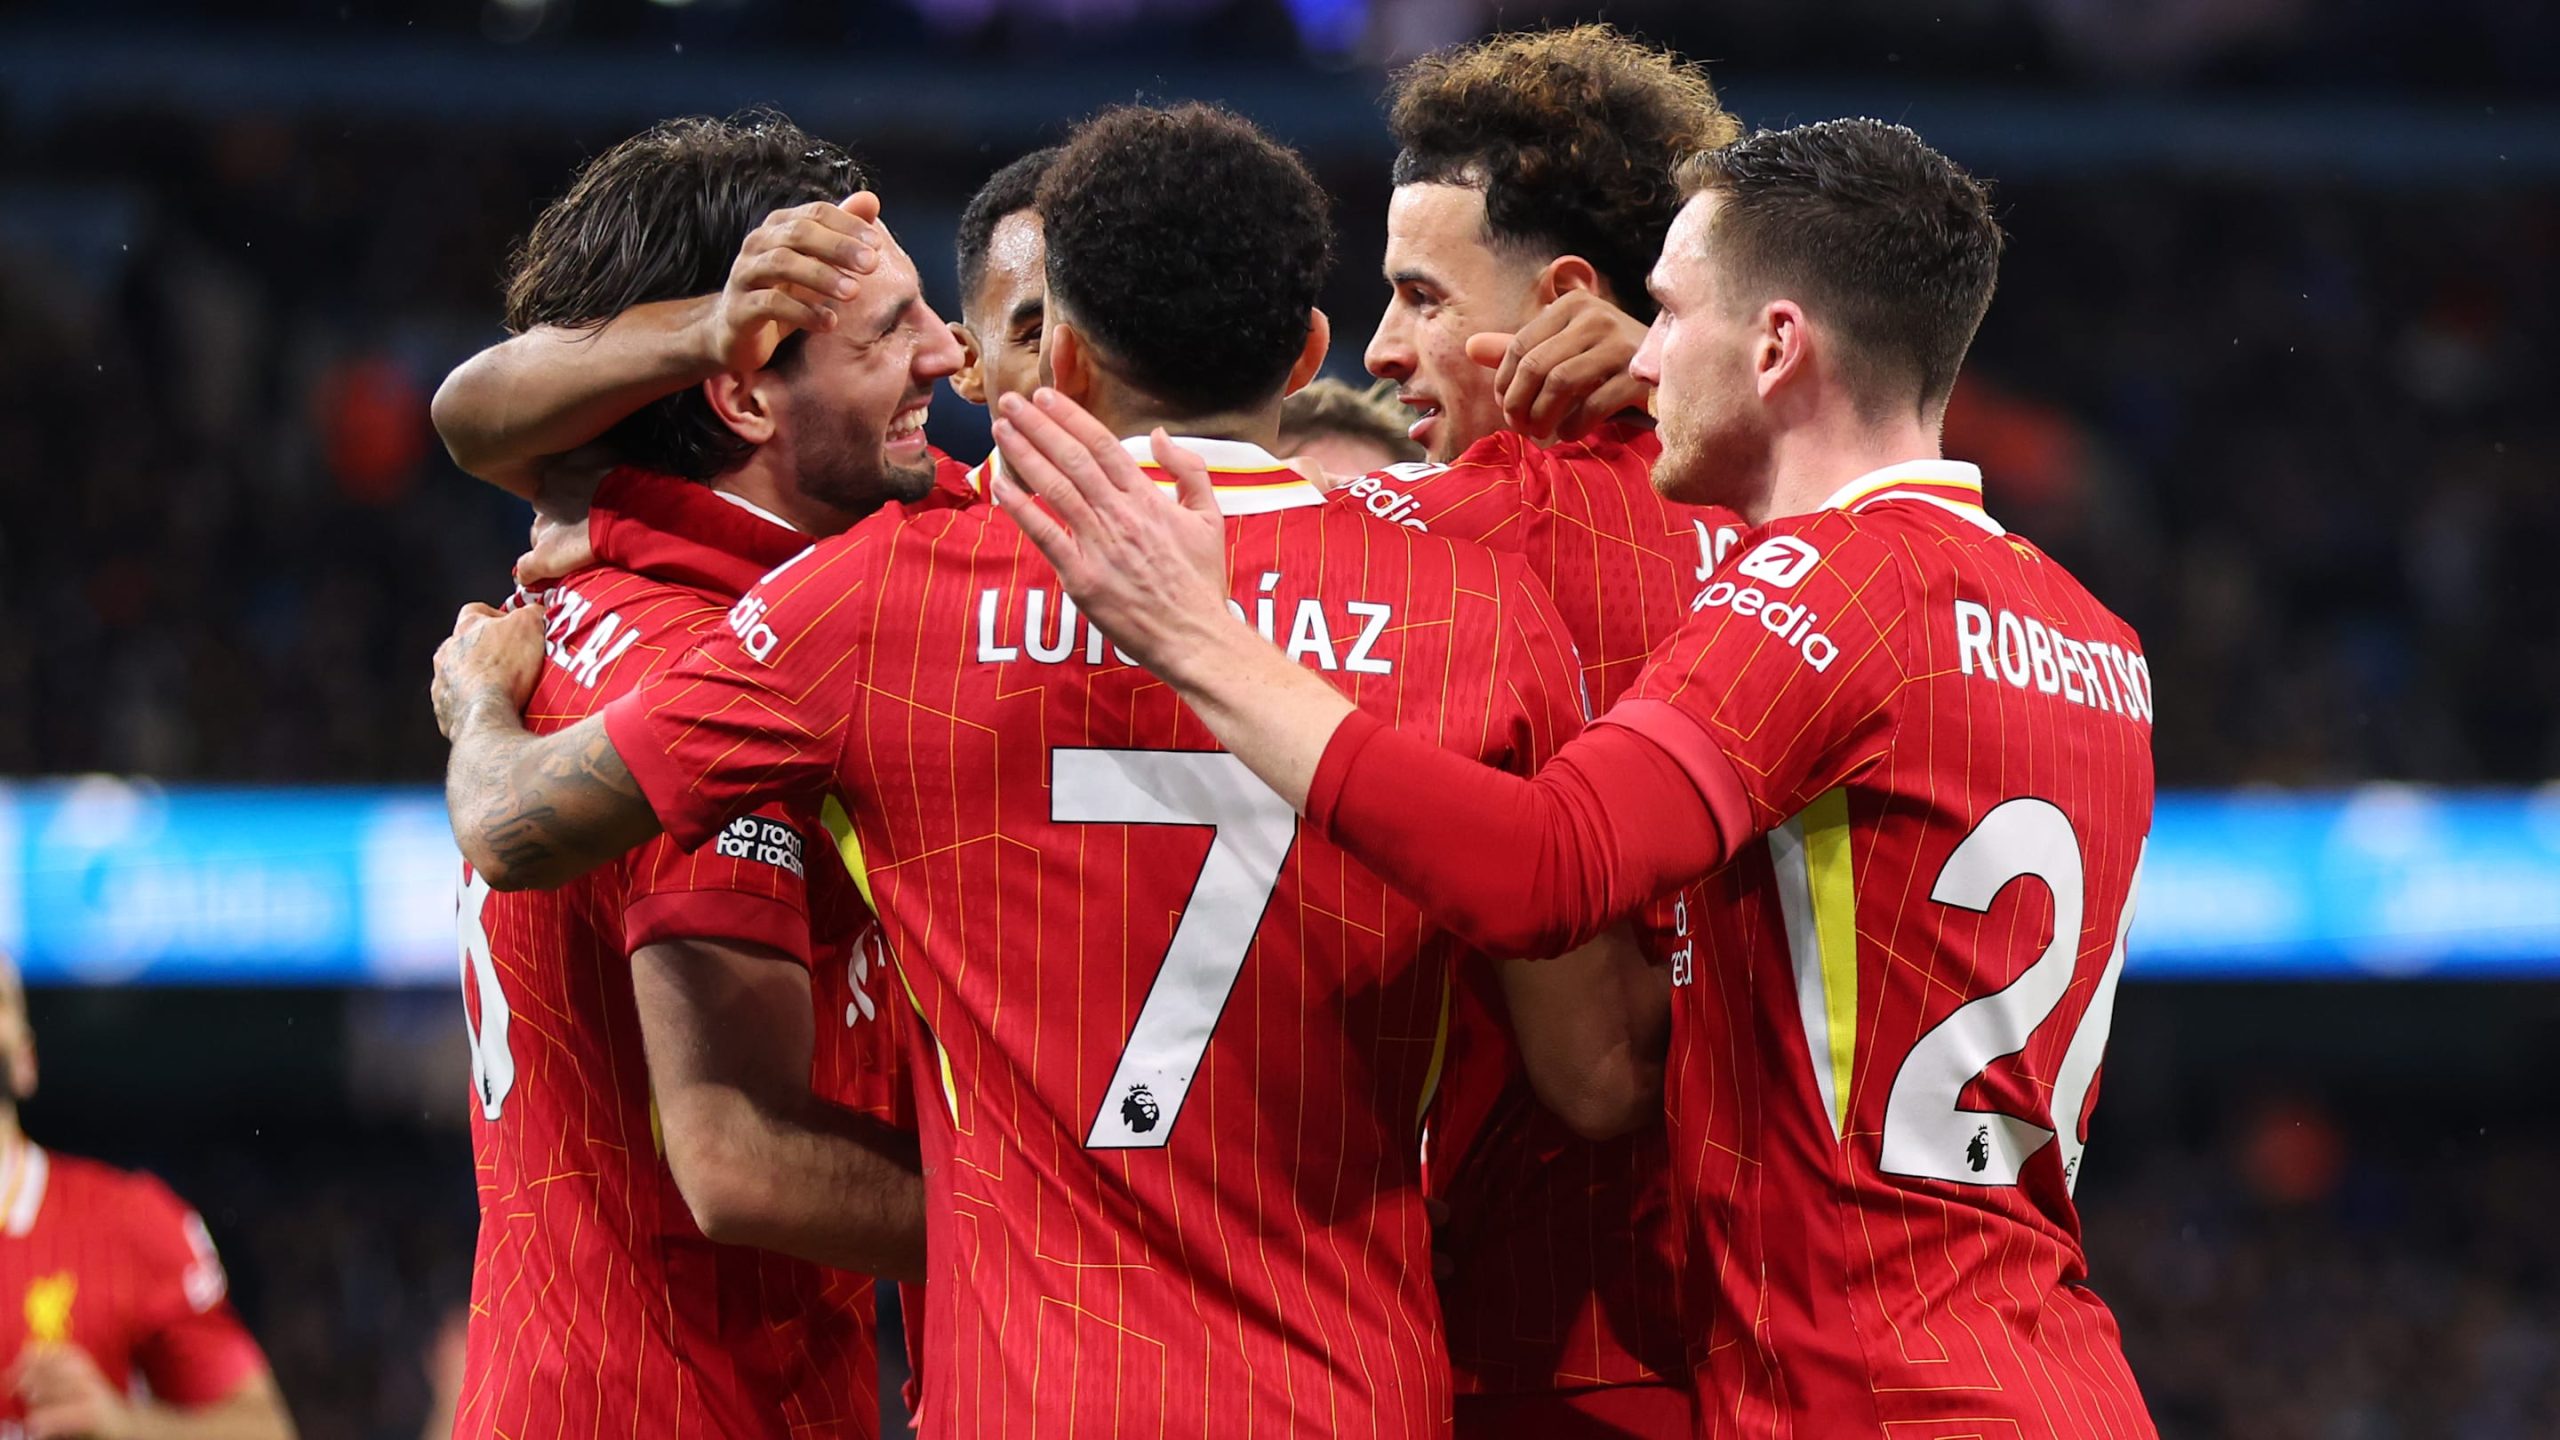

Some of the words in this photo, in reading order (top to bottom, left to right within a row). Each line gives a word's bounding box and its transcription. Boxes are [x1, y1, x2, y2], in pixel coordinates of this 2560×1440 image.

[729, 592, 779, 663] dia
[977, 588, 1139, 665] LUI
[1227, 571, 1393, 674] ÍAZ
[1689, 581, 1840, 674] pedia
[1954, 598, 2153, 725] ROBERTSO
[716, 830, 754, 858] for
[1050, 746, 1299, 1149] 7
